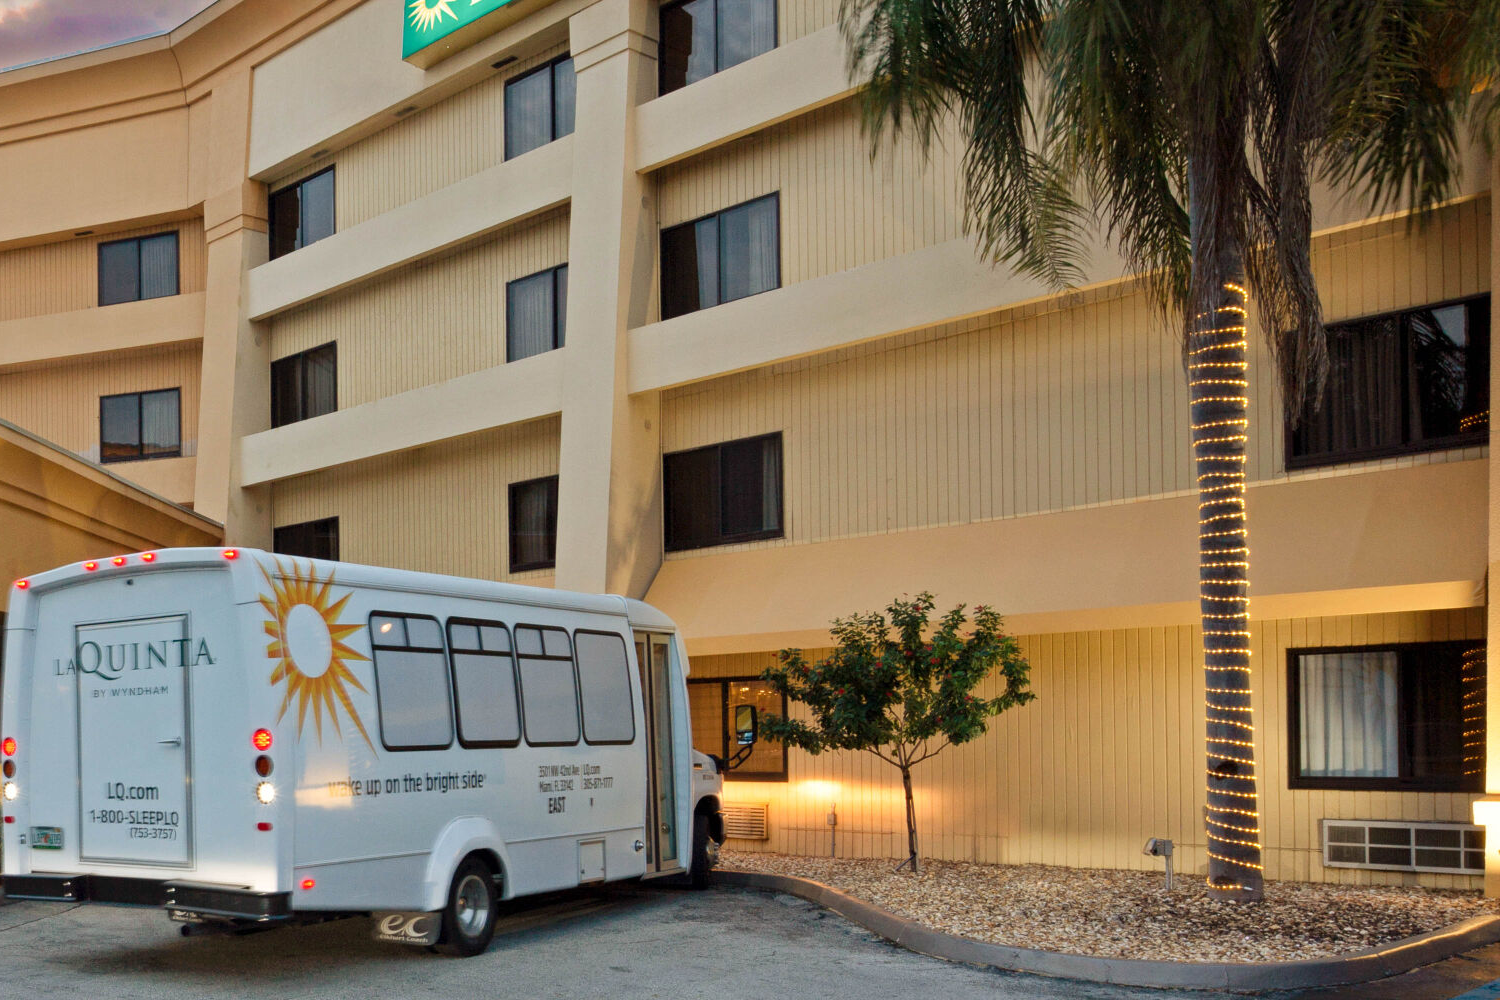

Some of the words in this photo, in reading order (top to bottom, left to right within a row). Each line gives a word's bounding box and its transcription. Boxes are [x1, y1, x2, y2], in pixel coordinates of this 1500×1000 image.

[54, 658, 77, 676] LA
[77, 637, 216, 681] QUINTA
[93, 689, 106, 698] BY
[112, 686, 169, 697] WYNDHAM
[107, 782, 159, 800] LQ.com
[328, 776, 362, 797] wake
[366, 778, 381, 797] up
[386, 778, 399, 794] on
[403, 773, 422, 792] the
[426, 771, 459, 793] bright
[462, 770, 484, 789] side
[548, 797, 566, 814] EAST
[90, 809, 179, 827] 1-800-SLEEPLQ
[130, 827, 177, 840] (753-3757)
